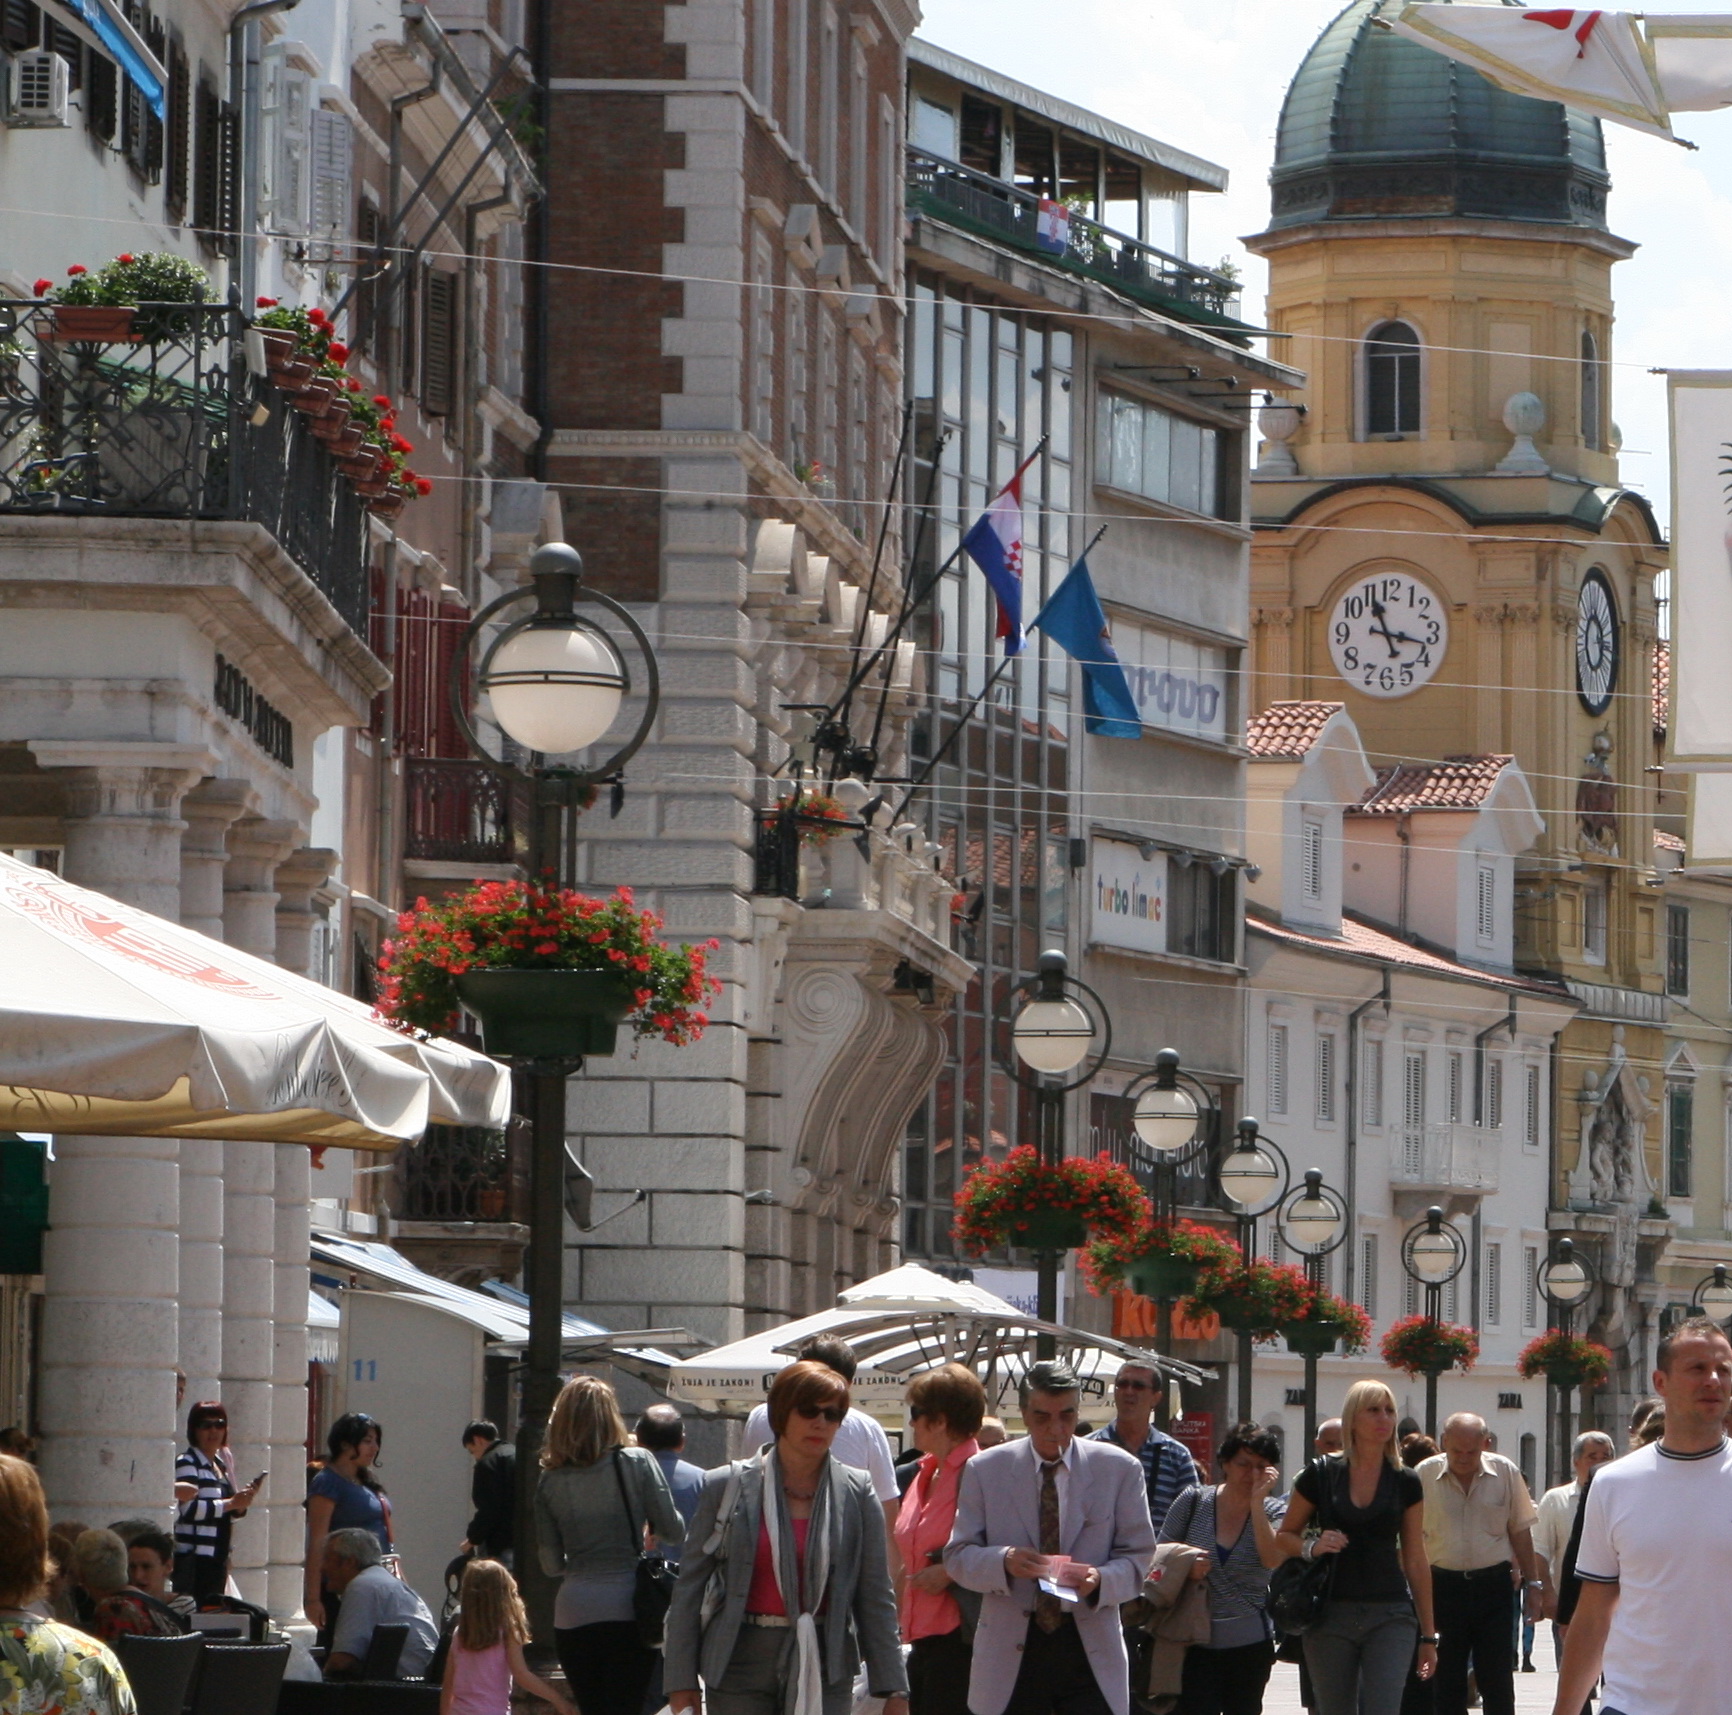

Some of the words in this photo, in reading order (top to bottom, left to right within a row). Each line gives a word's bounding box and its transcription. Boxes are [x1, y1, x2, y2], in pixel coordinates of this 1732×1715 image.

[1362, 583, 1377, 608] 11
[1381, 579, 1401, 602] 12
[1408, 585, 1415, 608] 1
[1344, 596, 1363, 619] 10
[1418, 597, 1430, 620] 2
[1335, 621, 1350, 645] 9
[1426, 620, 1440, 645] 3
[1344, 646, 1359, 670] 8
[1415, 642, 1431, 668] 4
[1363, 662, 1378, 686] 7
[1380, 666, 1395, 691] 6
[1400, 661, 1415, 686] 5
[1097, 873, 1129, 915] turbo
[352, 1359, 377, 1381] 11
[706, 1378, 716, 1387] JE
[1498, 1392, 1522, 1409] ZARA
